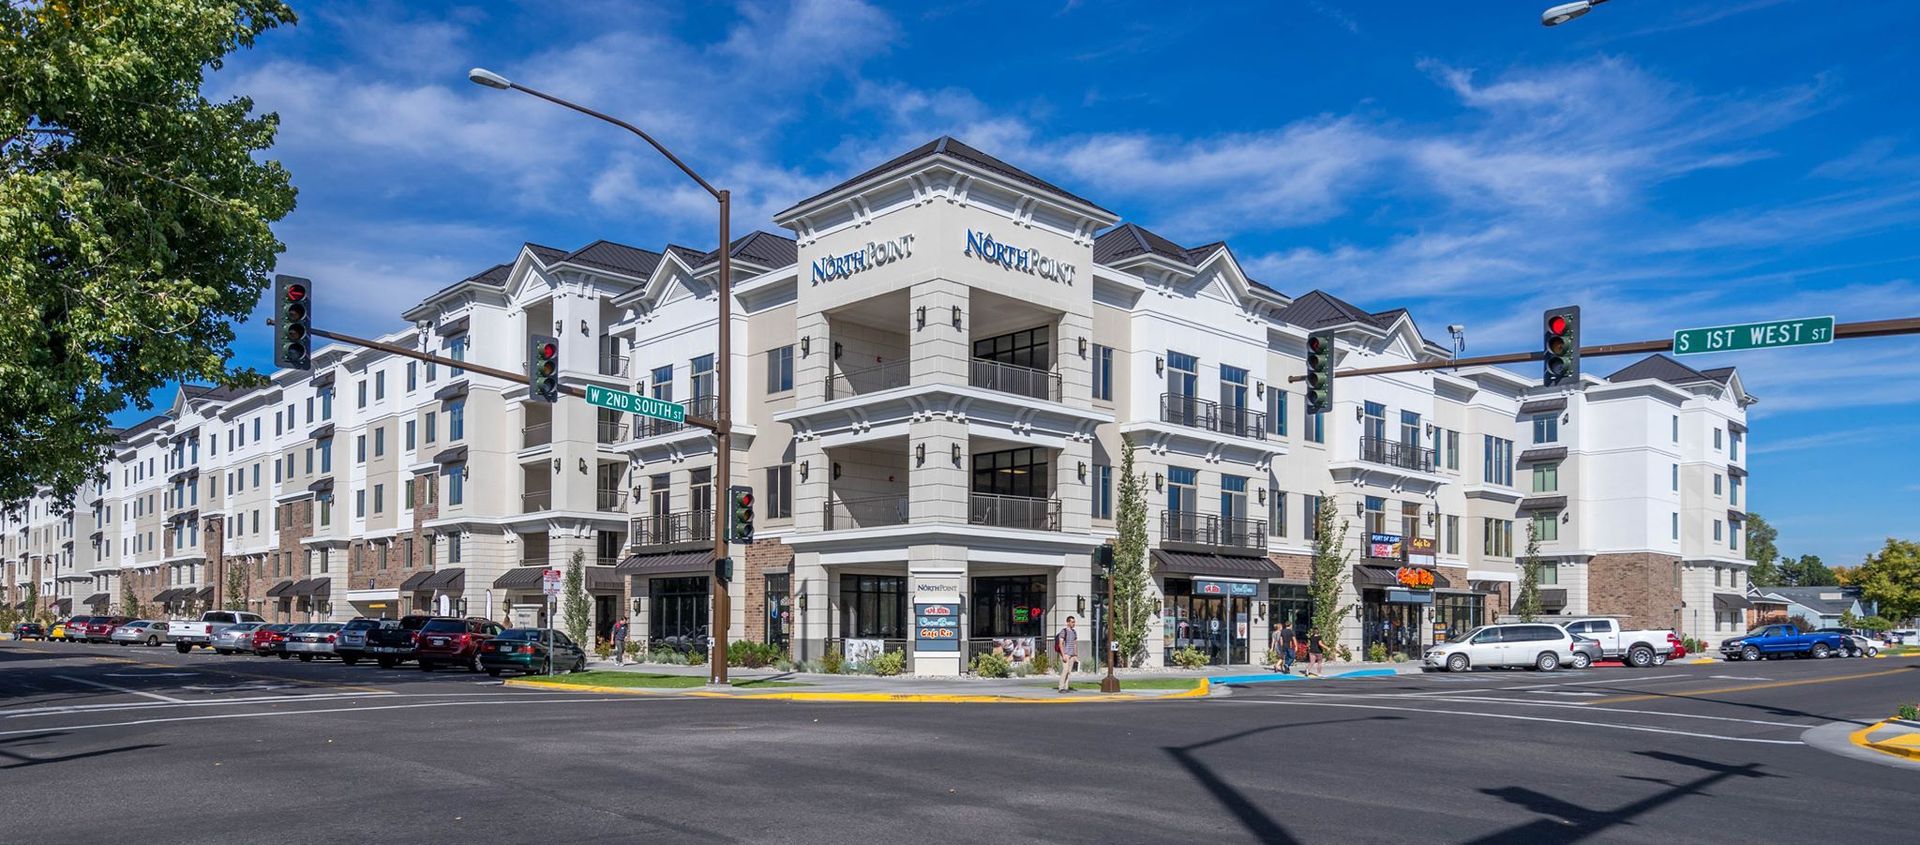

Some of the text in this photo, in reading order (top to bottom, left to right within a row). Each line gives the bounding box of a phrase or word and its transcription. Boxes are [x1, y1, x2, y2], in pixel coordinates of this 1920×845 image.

[1679, 323, 1827, 351] S 1ST WEST ST
[591, 388, 682, 420] W 2ND SOUTH ST
